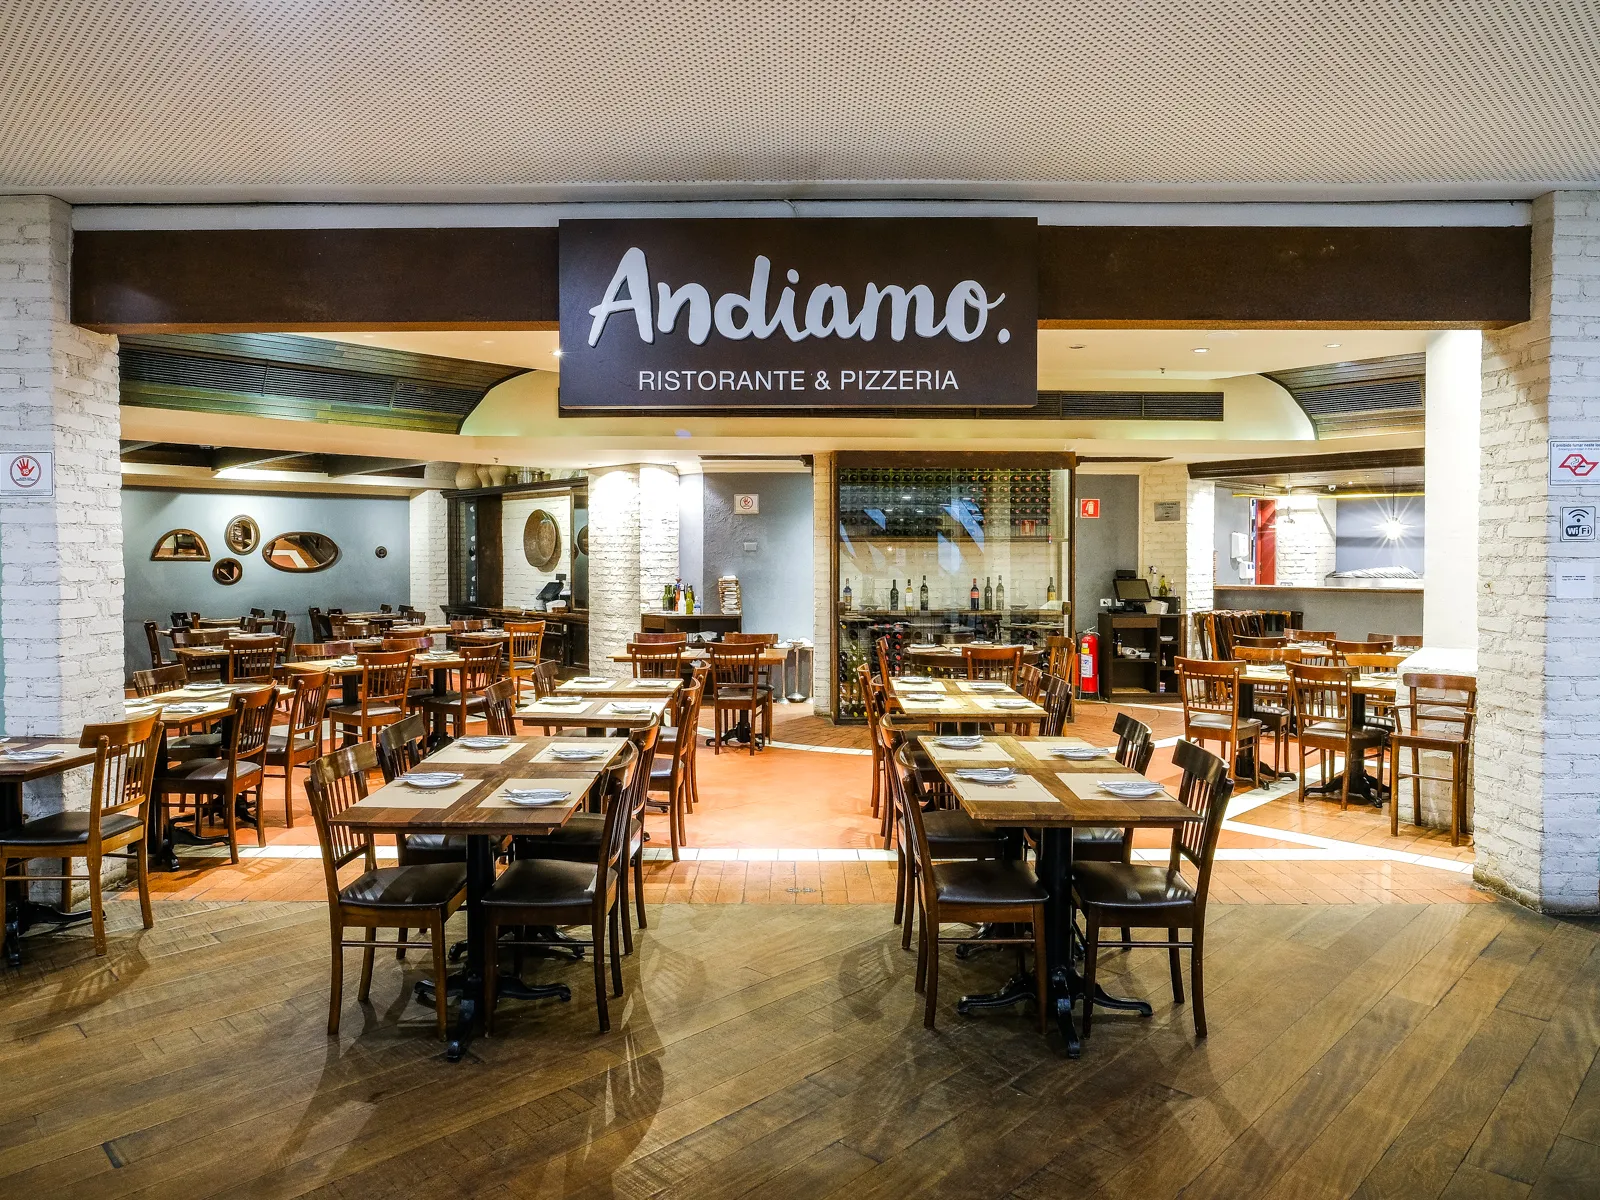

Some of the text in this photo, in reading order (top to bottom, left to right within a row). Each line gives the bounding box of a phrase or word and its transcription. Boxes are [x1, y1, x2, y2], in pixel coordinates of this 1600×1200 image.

[588, 247, 1011, 347] Andiamo.
[638, 370, 960, 391] RISTORANTE & PIZZERIA
